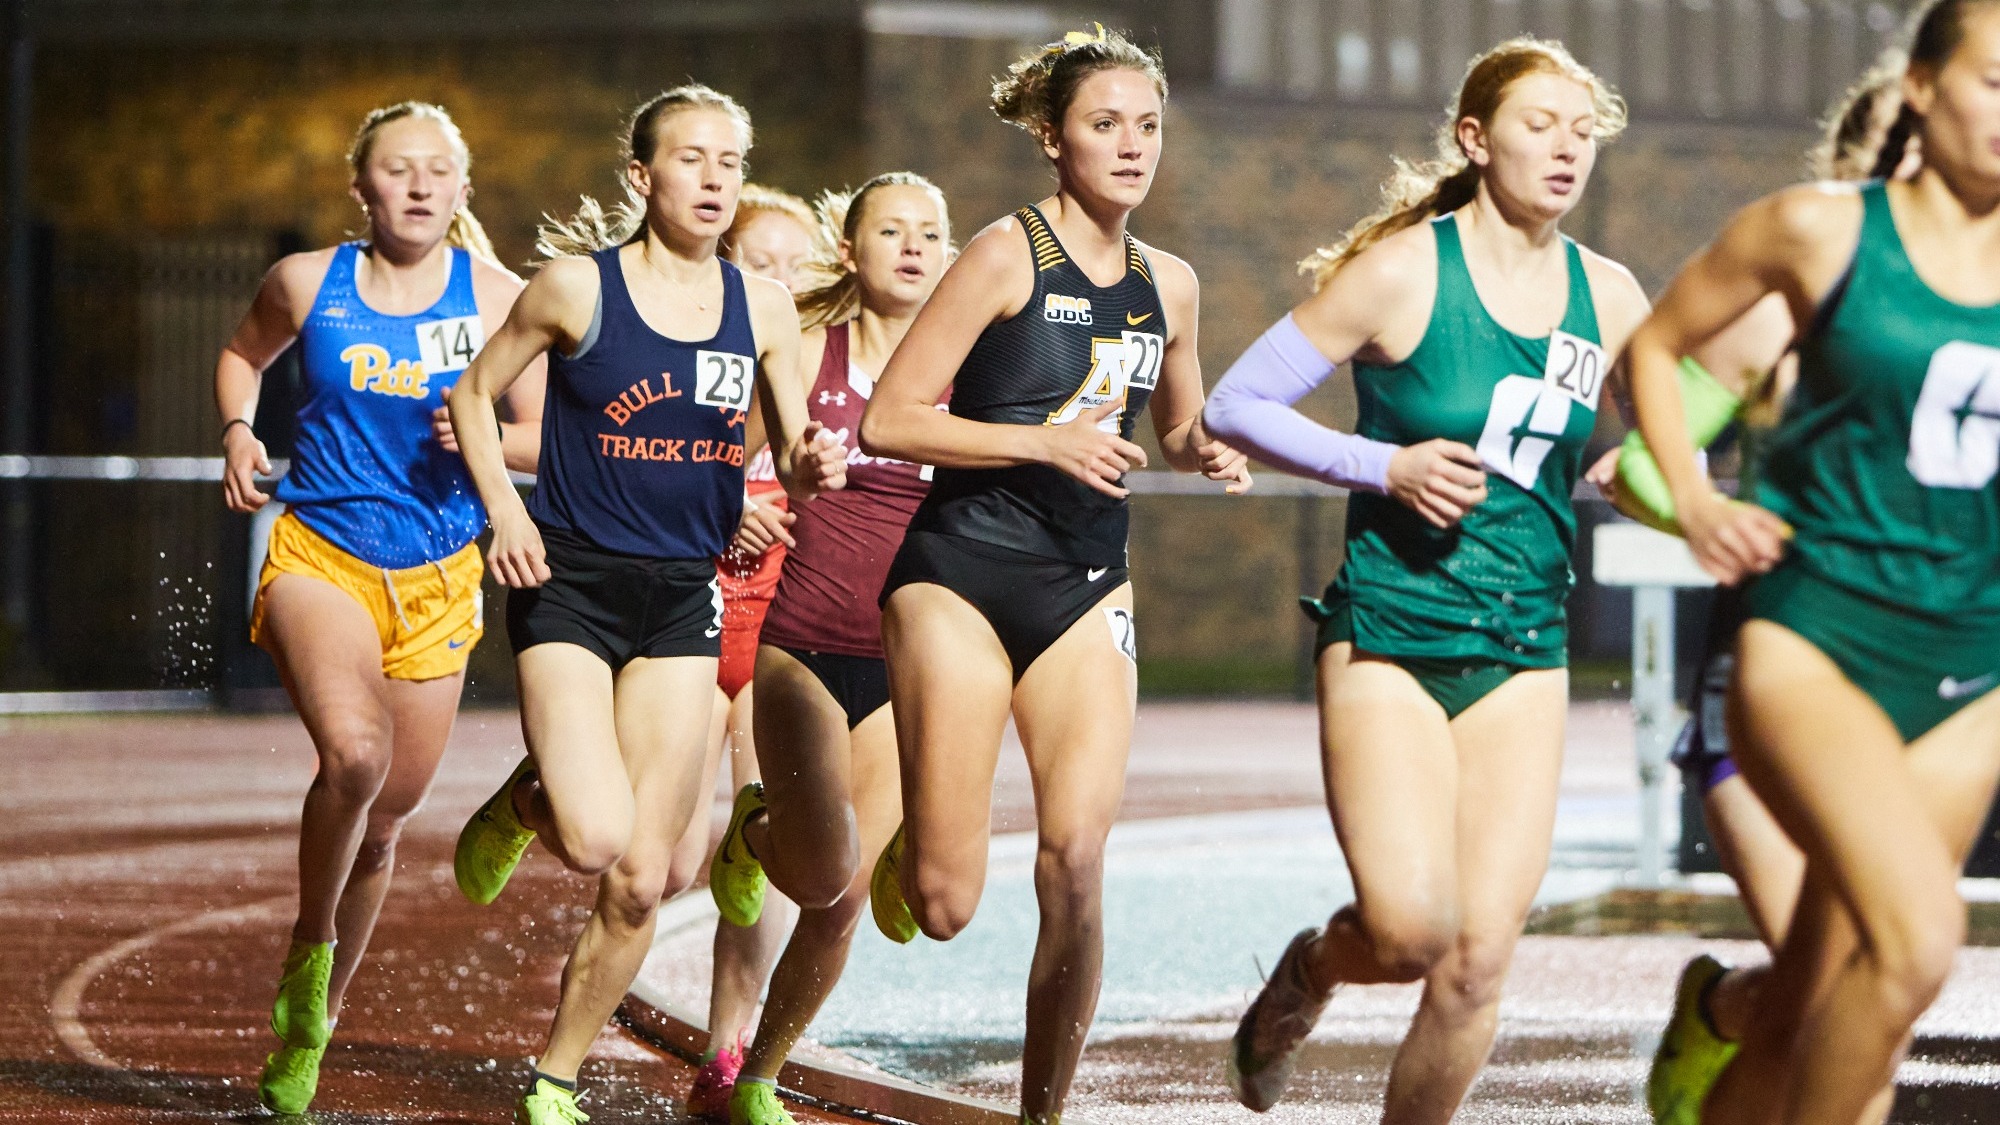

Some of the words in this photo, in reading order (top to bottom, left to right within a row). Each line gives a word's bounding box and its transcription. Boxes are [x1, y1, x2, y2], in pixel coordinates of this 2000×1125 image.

[1044, 293, 1093, 325] SBC
[430, 321, 475, 367] 14
[1129, 335, 1160, 387] 22
[340, 343, 430, 400] Pitt
[705, 355, 746, 406] 23
[1556, 340, 1597, 400] 20
[603, 371, 683, 428] BULL
[598, 433, 686, 463] TRACK
[691, 439, 745, 468] CLUB
